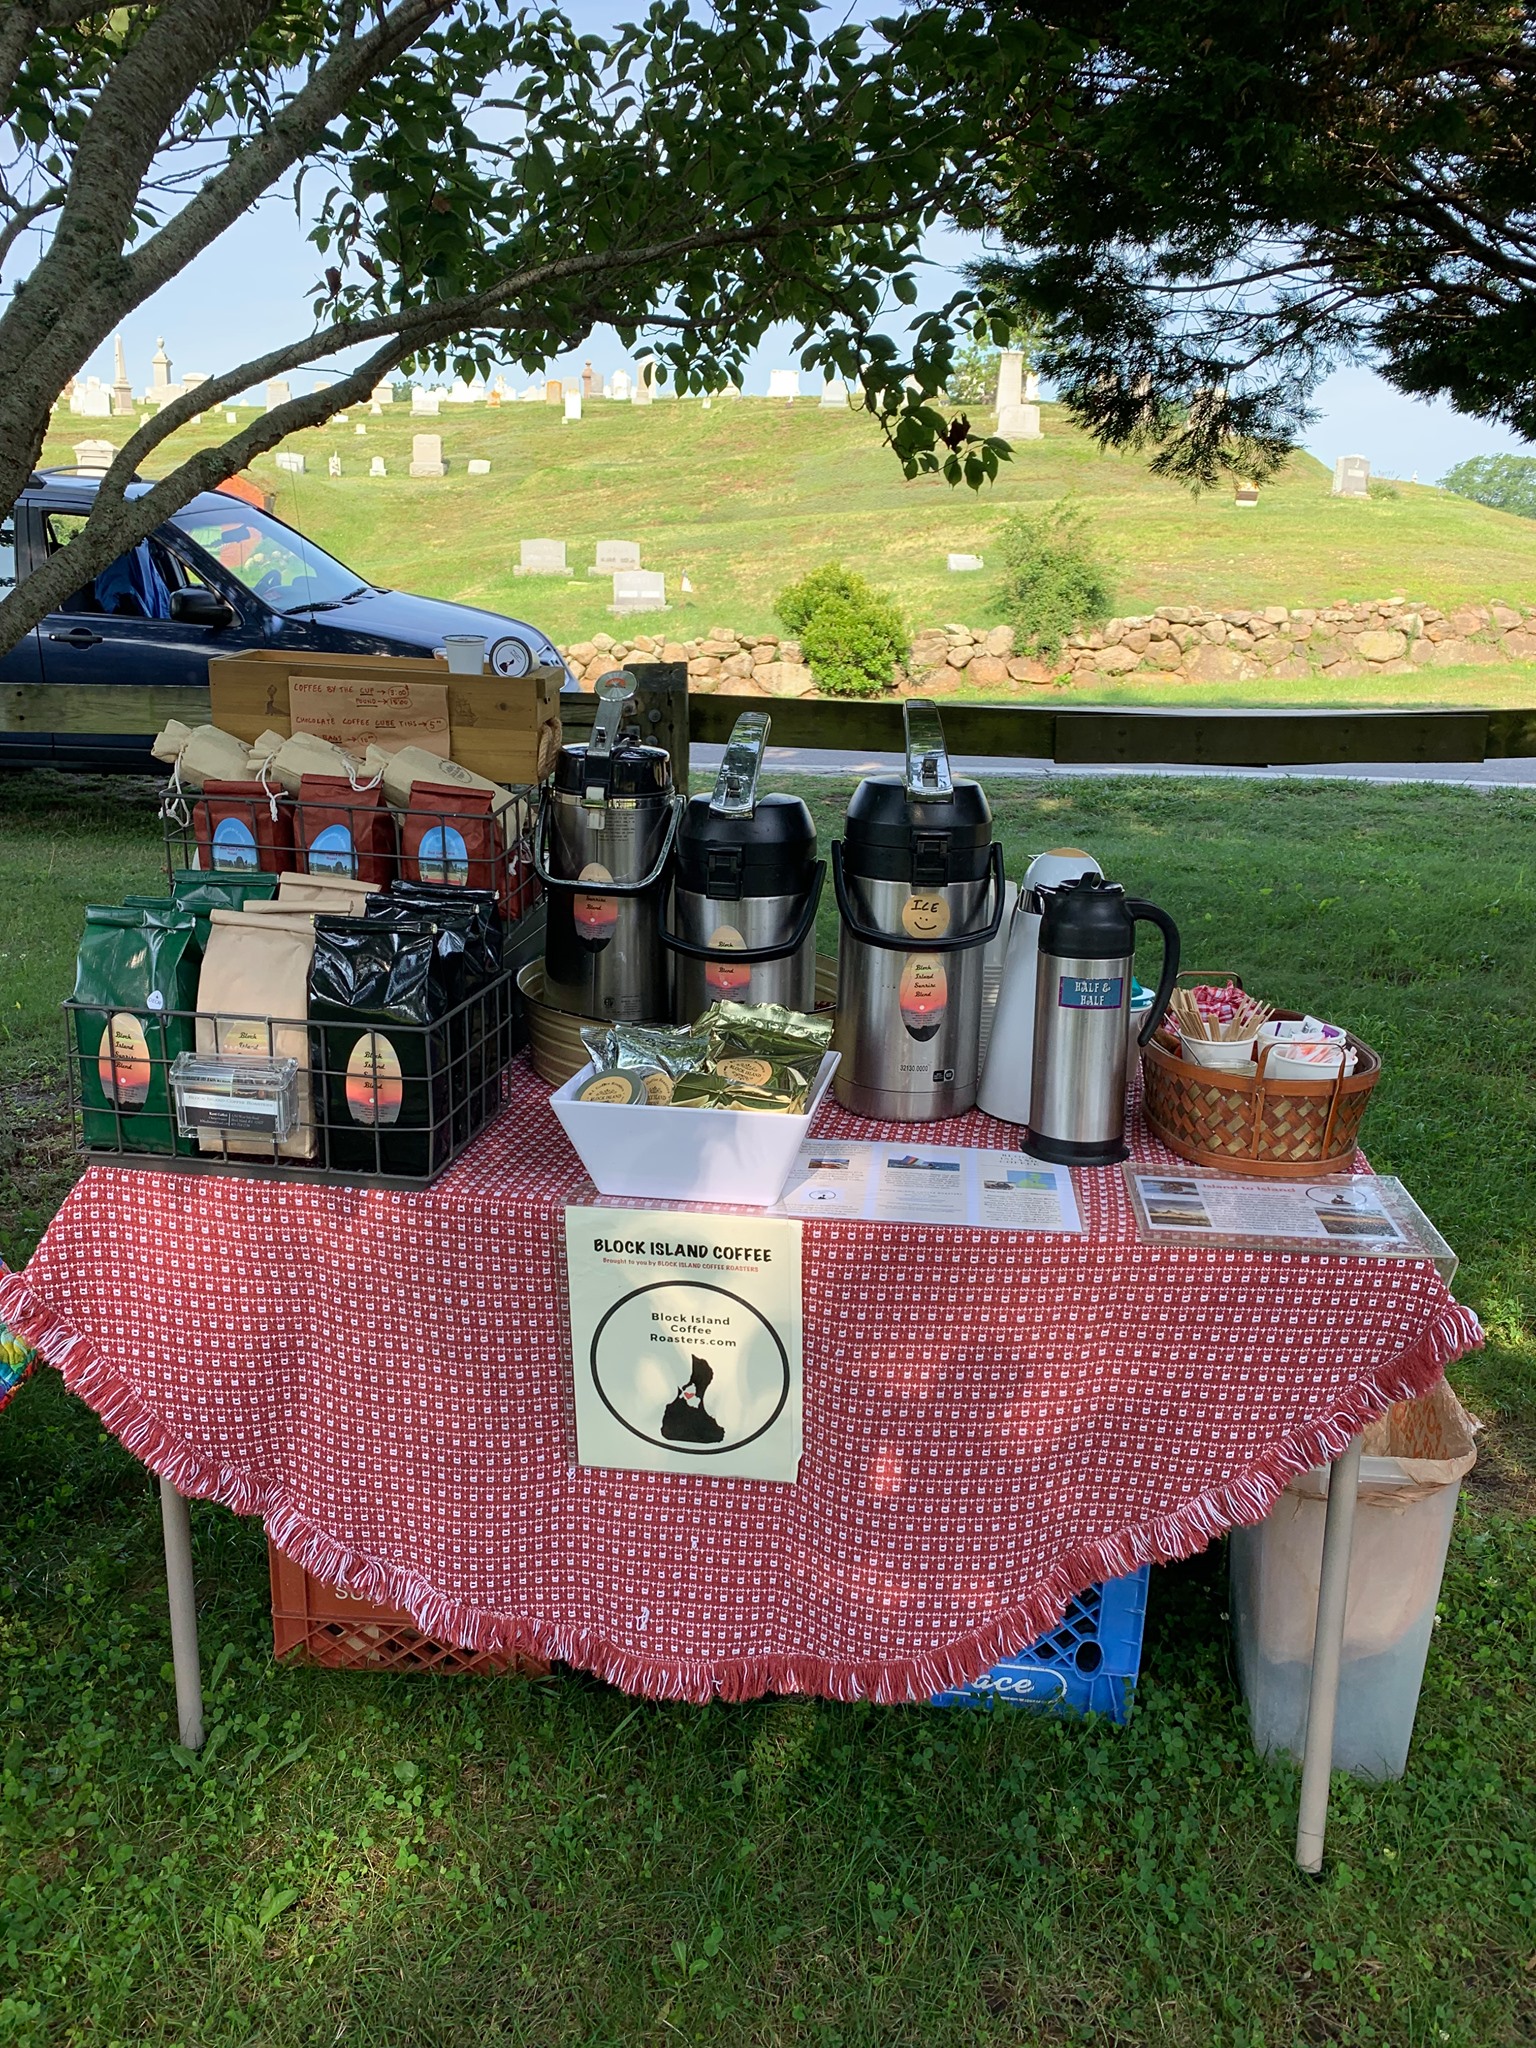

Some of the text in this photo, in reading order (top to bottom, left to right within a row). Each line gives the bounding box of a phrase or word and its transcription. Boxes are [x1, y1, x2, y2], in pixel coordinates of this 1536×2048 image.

[294, 683, 322, 693] COFFEE
[326, 685, 337, 693] BY
[339, 685, 354, 693] THE
[295, 716, 336, 725] CHOCOLATE
[342, 718, 370, 726] COFFEE
[911, 900, 939, 913] ICE
[1075, 981, 1111, 993] HALF &
[1080, 995, 1105, 1006] HALF
[115, 1031, 132, 1040] Block
[115, 1041, 135, 1050] Island
[238, 1042, 259, 1050] Island
[115, 1062, 133, 1070] Blend
[729, 1064, 745, 1073] BLOCK
[744, 1070, 762, 1078] ISLAND
[1256, 1185, 1296, 1193] Island
[594, 1239, 772, 1262] BLOCK ISLAND COFFEE
[602, 1257, 627, 1265] Brought
[678, 1261, 702, 1269] ISLAND
[702, 1263, 725, 1271] COFFEE
[726, 1265, 759, 1273] ROASTERS
[651, 1312, 730, 1326] Block Island
[670, 1324, 712, 1335] Coffee
[650, 1333, 737, 1347] Roasters.com
[970, 1674, 1035, 1693] ace
